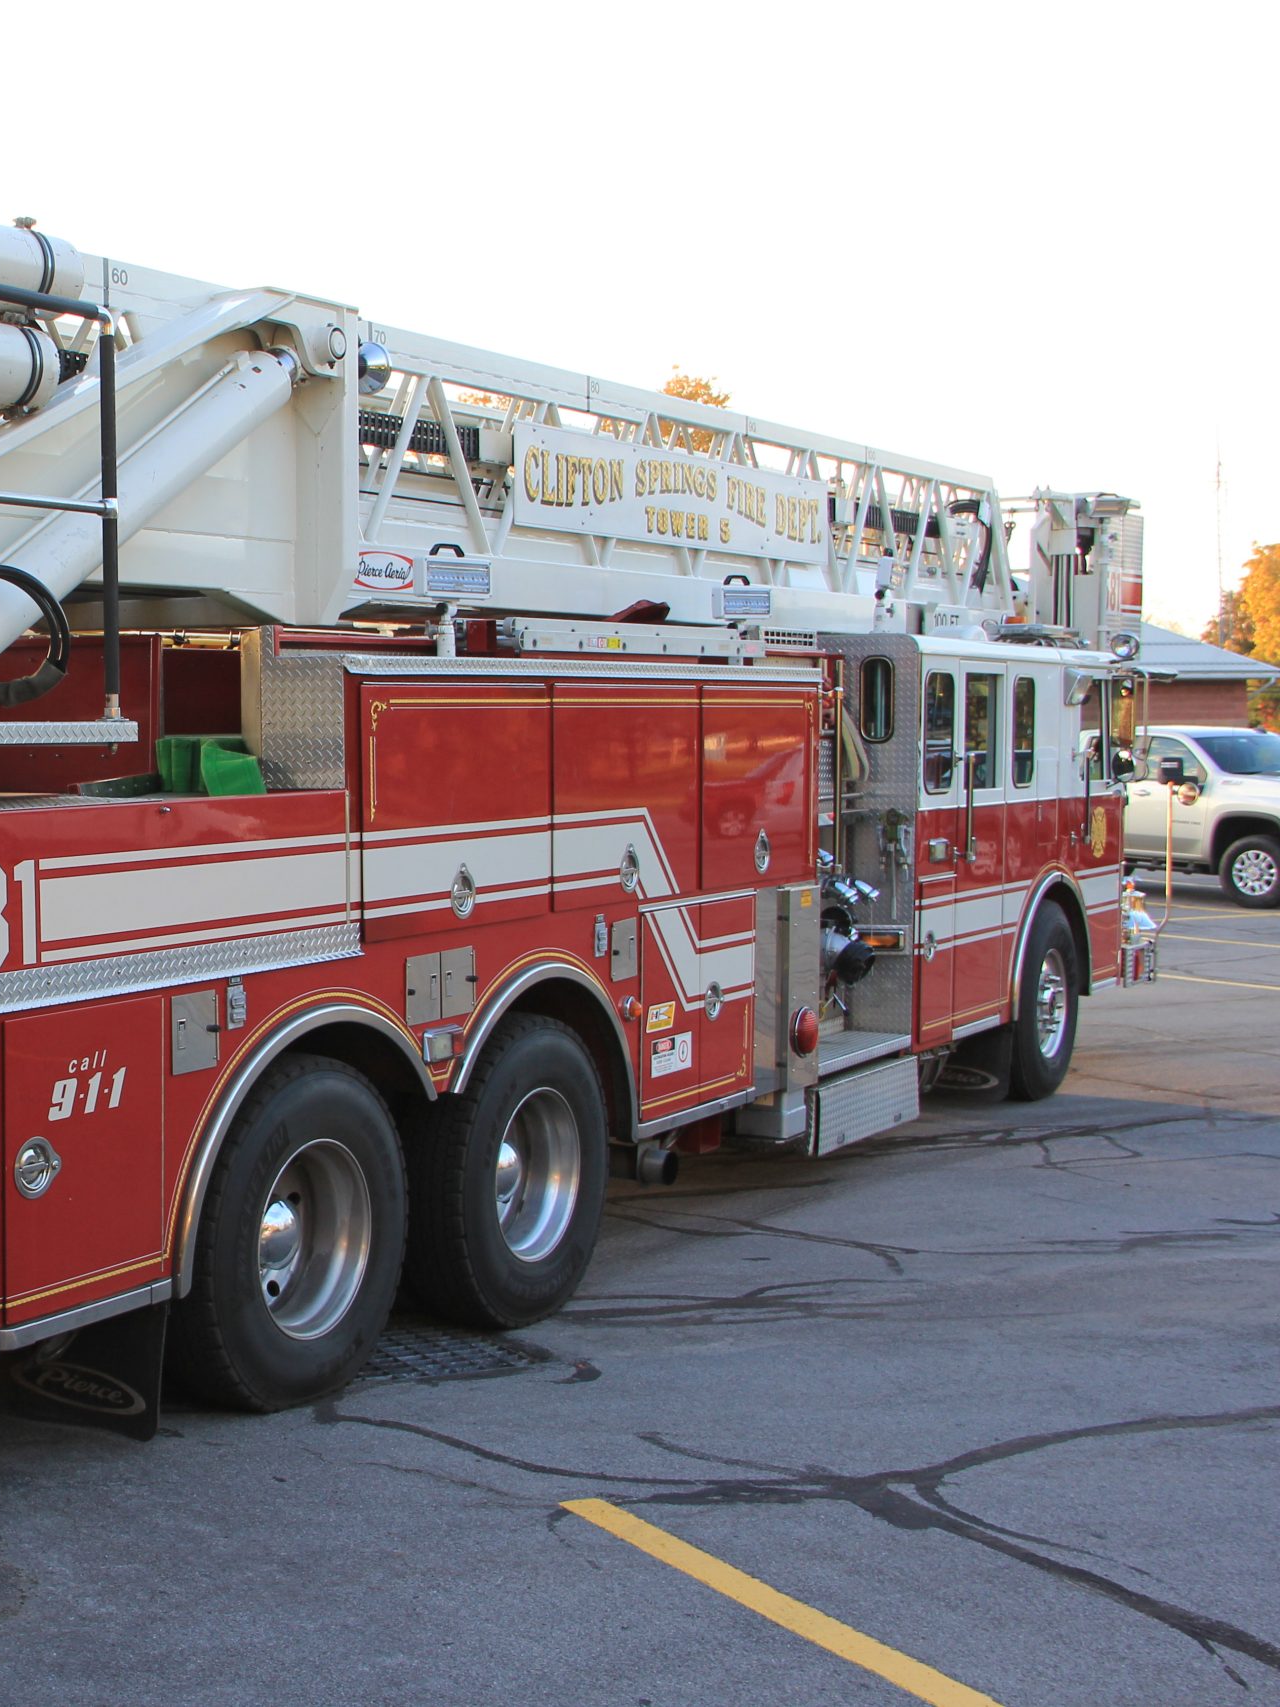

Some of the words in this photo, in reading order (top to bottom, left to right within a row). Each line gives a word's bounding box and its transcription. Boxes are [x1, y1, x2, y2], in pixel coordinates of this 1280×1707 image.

[112, 268, 128, 285] 60
[374, 330, 386, 345] 70
[591, 381, 599, 394] 80
[524, 444, 624, 507] CLIFTON
[635, 458, 718, 501] SPRINGS
[726, 475, 767, 528] FIRE
[775, 492, 822, 544] DEPT.
[645, 506, 709, 541] TOWER
[357, 556, 383, 579] Pierce
[385, 562, 411, 584] Aerial
[68, 1049, 107, 1074] call
[37, 1368, 125, 1403] Pierce
